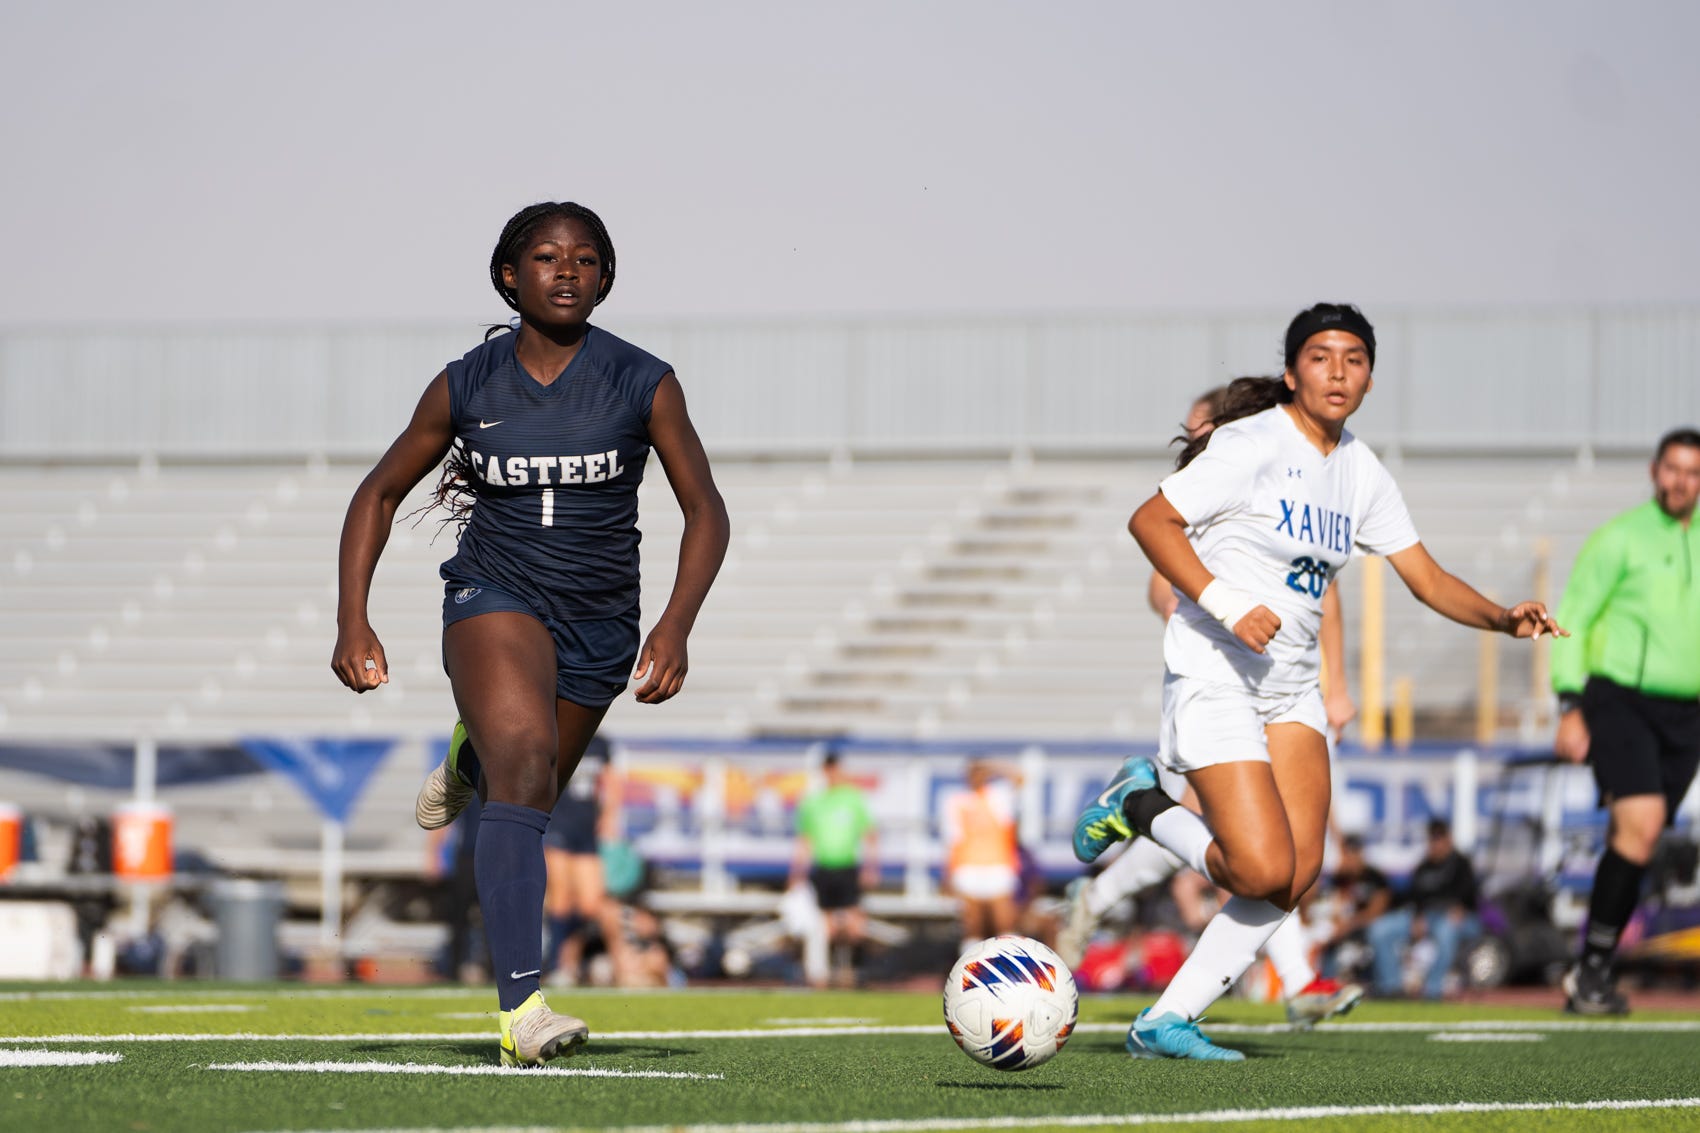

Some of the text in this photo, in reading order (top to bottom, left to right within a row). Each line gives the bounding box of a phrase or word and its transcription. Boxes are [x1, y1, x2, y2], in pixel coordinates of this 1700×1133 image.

[470, 449, 625, 487] CASTEEL
[541, 487, 555, 528] 1
[1275, 499, 1351, 555] XAVIER
